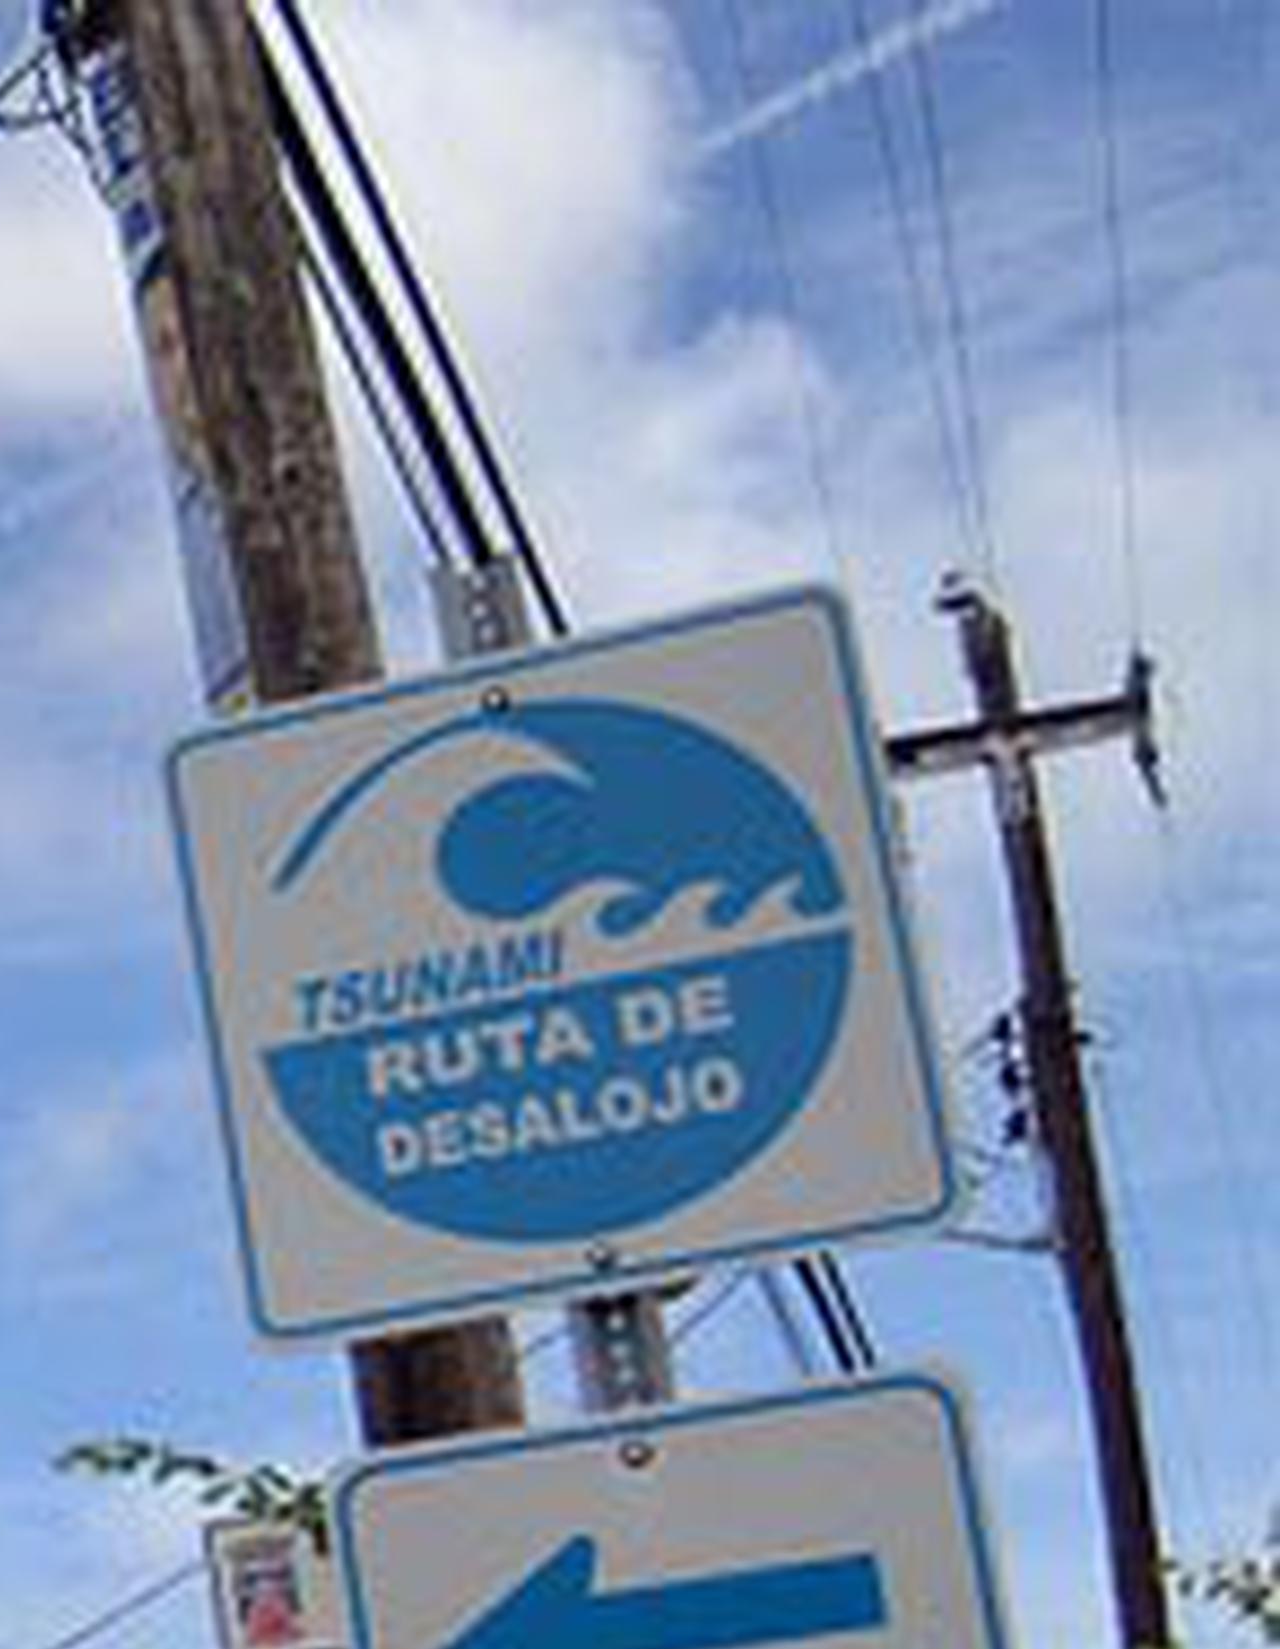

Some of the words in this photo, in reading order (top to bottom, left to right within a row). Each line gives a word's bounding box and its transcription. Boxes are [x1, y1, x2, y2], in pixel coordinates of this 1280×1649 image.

[294, 930, 563, 1030] TSUNAMI
[370, 1009, 594, 1098] RUTA
[618, 976, 734, 1045] DE
[380, 1058, 742, 1176] DESALOJO
